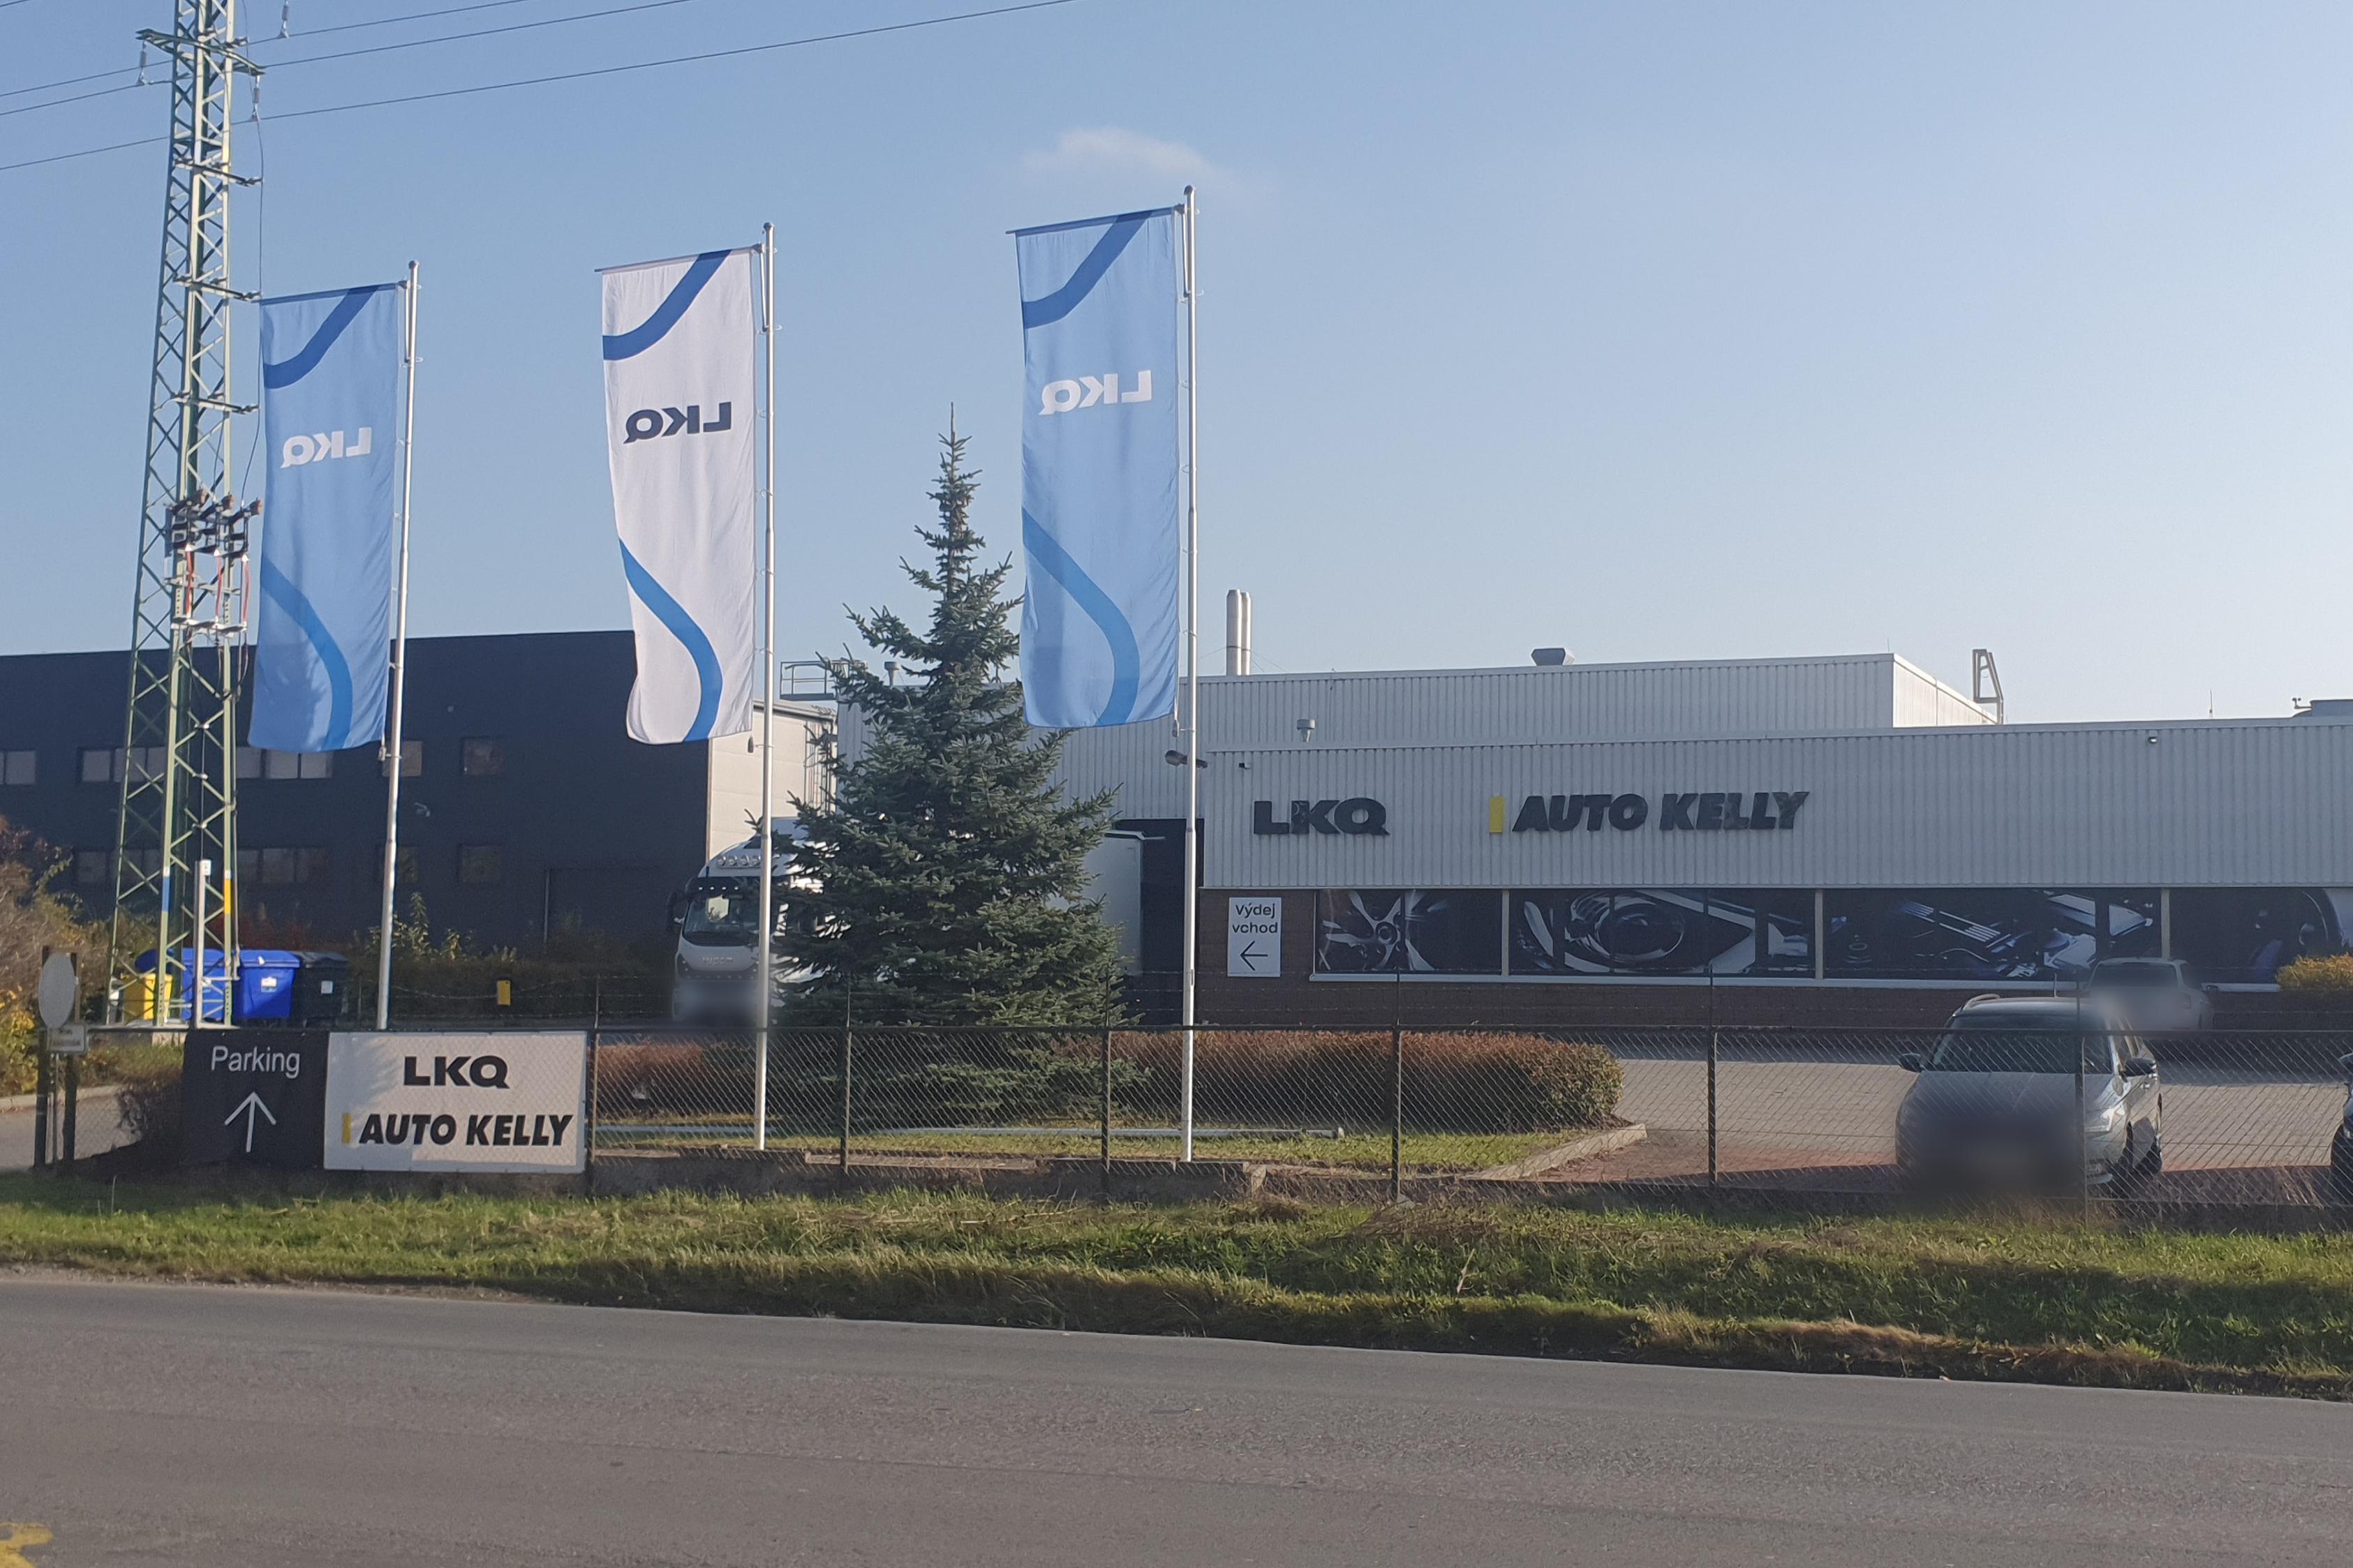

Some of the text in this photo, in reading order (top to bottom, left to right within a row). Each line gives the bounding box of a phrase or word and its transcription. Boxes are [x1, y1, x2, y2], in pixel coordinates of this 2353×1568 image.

[1254, 798, 1390, 835] LKQ
[1512, 791, 1810, 832] AUTO KELLY
[1235, 902, 1275, 919] Výdej
[1232, 922, 1278, 934] vchod
[211, 1045, 300, 1078] Parking
[403, 1055, 510, 1089] LKQ
[359, 1114, 573, 1145] AUTO KELLY
